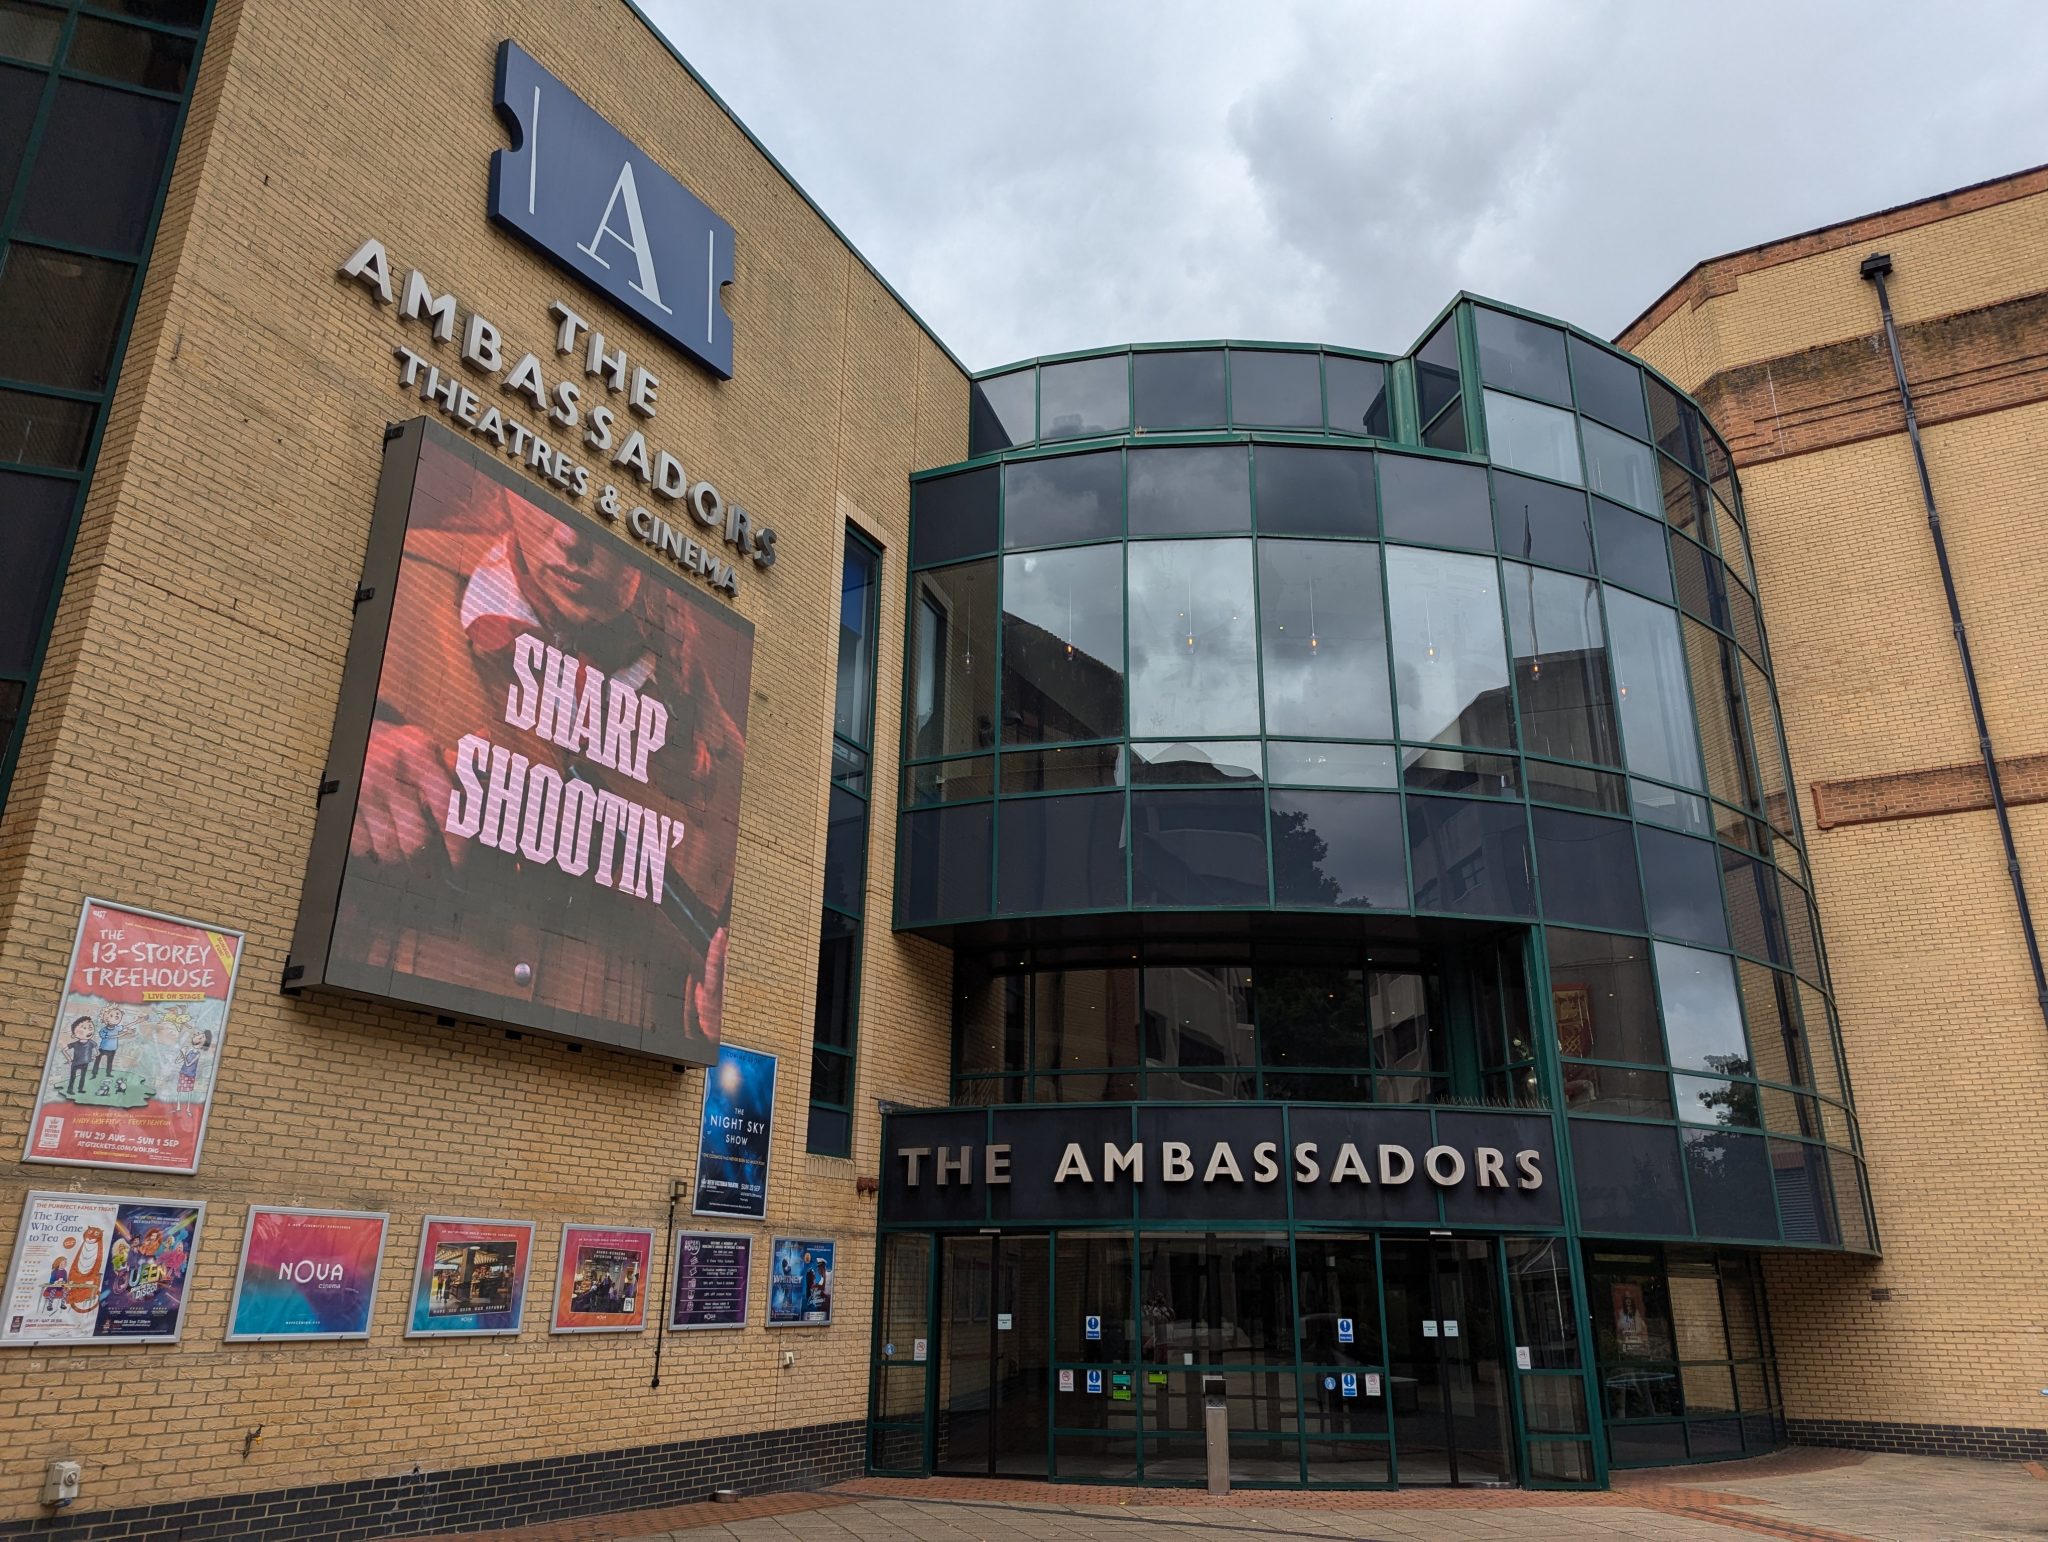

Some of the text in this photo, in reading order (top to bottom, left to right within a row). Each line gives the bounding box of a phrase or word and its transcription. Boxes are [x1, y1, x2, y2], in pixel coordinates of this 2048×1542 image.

[577, 161, 672, 315] A
[549, 300, 659, 418] THE
[338, 238, 777, 568] AMBASSADORS
[394, 345, 738, 597] THEATRES & CINEMA
[505, 633, 668, 783] SHARP
[100, 930, 125, 939] THE
[92, 942, 211, 966] 13-STOREY
[83, 967, 215, 988] TREEHOUSE
[734, 1107, 745, 1116] THE
[710, 1114, 765, 1135] NIGHT SKY
[74, 1130, 91, 1139] THU
[108, 1133, 126, 1142] AUG
[136, 1136, 154, 1145] SUN
[163, 1139, 180, 1148] SEP
[725, 1133, 748, 1145] SHOW
[898, 1142, 1543, 1190] THE AMBASSADORS
[31, 1222, 83, 1232] Who Came
[34, 1212, 79, 1222] The Tiger
[28, 1234, 58, 1242] to Tea
[278, 1260, 344, 1284] NOVA
[774, 1275, 803, 1284] WHITNEY
